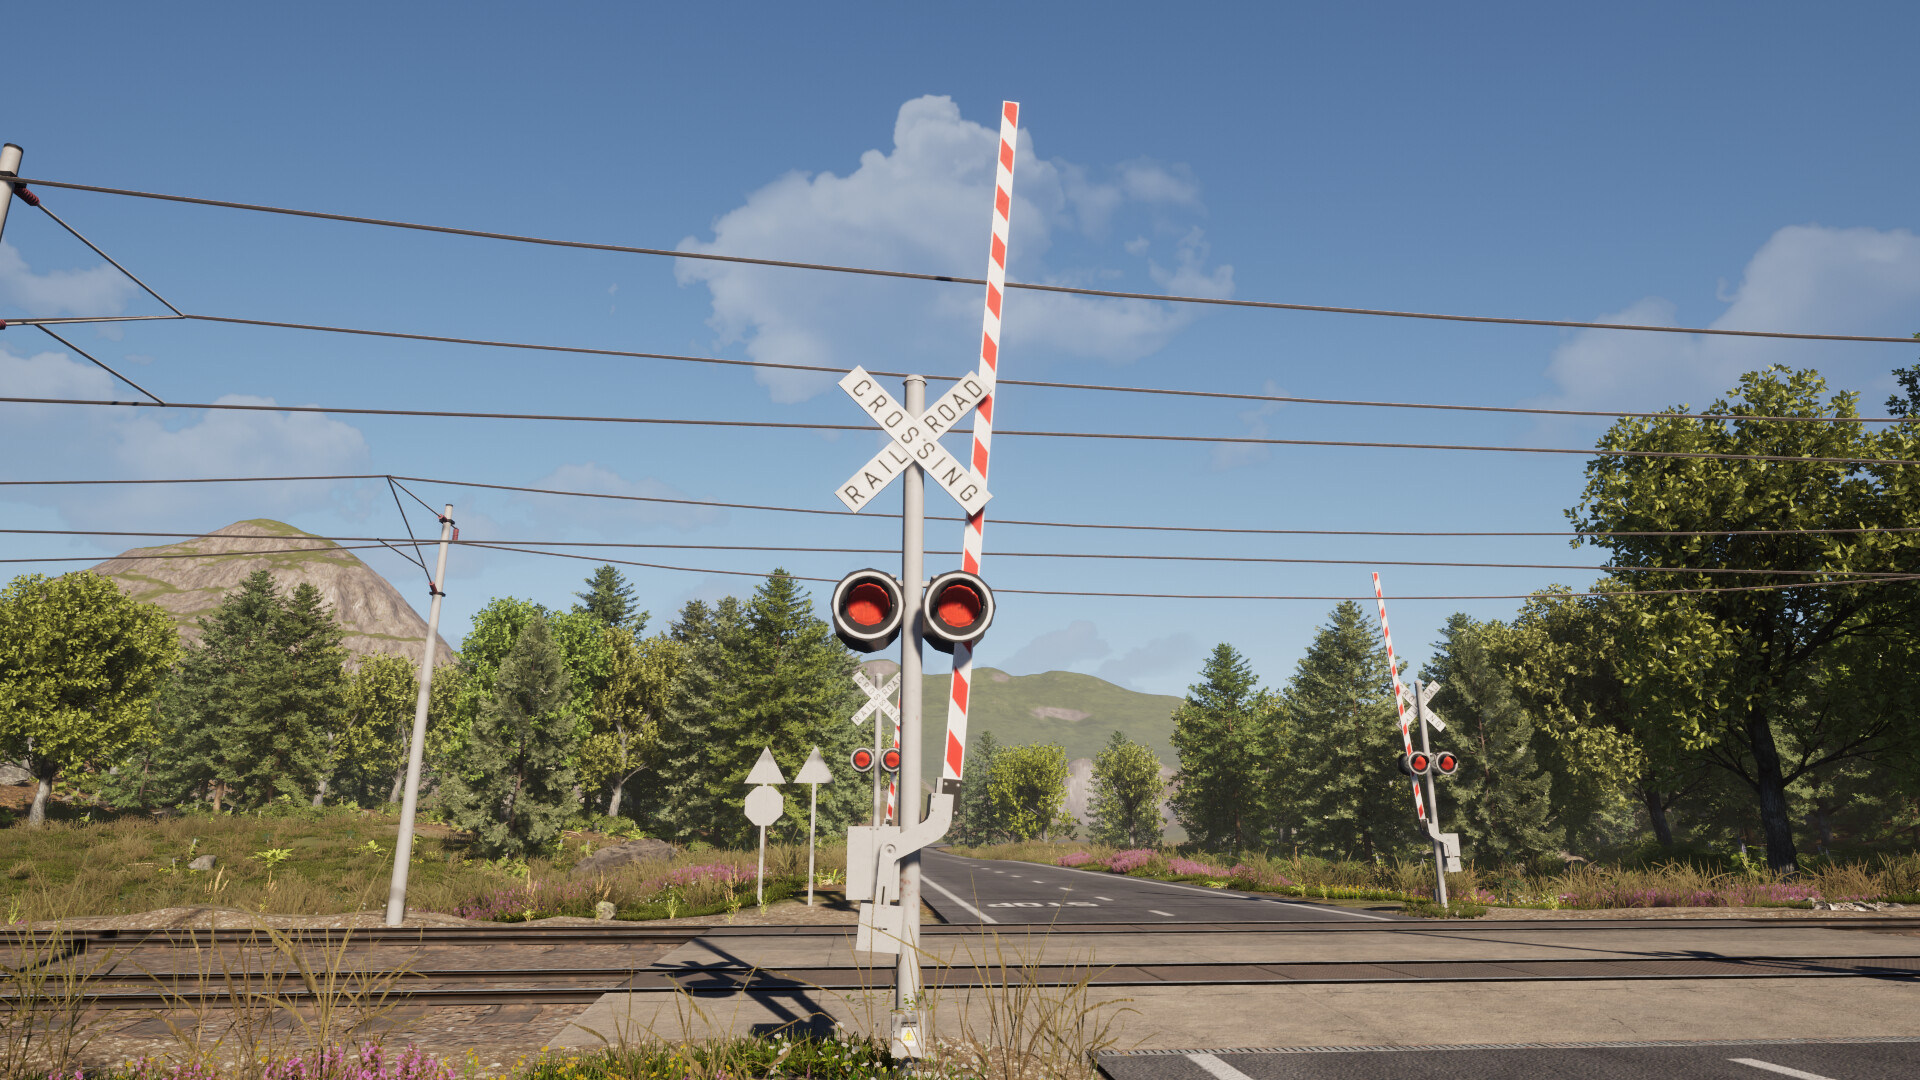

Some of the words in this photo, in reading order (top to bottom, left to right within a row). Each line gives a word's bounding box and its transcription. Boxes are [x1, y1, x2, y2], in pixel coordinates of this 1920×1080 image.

[844, 450, 908, 504] RAIL
[923, 380, 983, 433] ROAD
[852, 379, 978, 502] CROSSING
